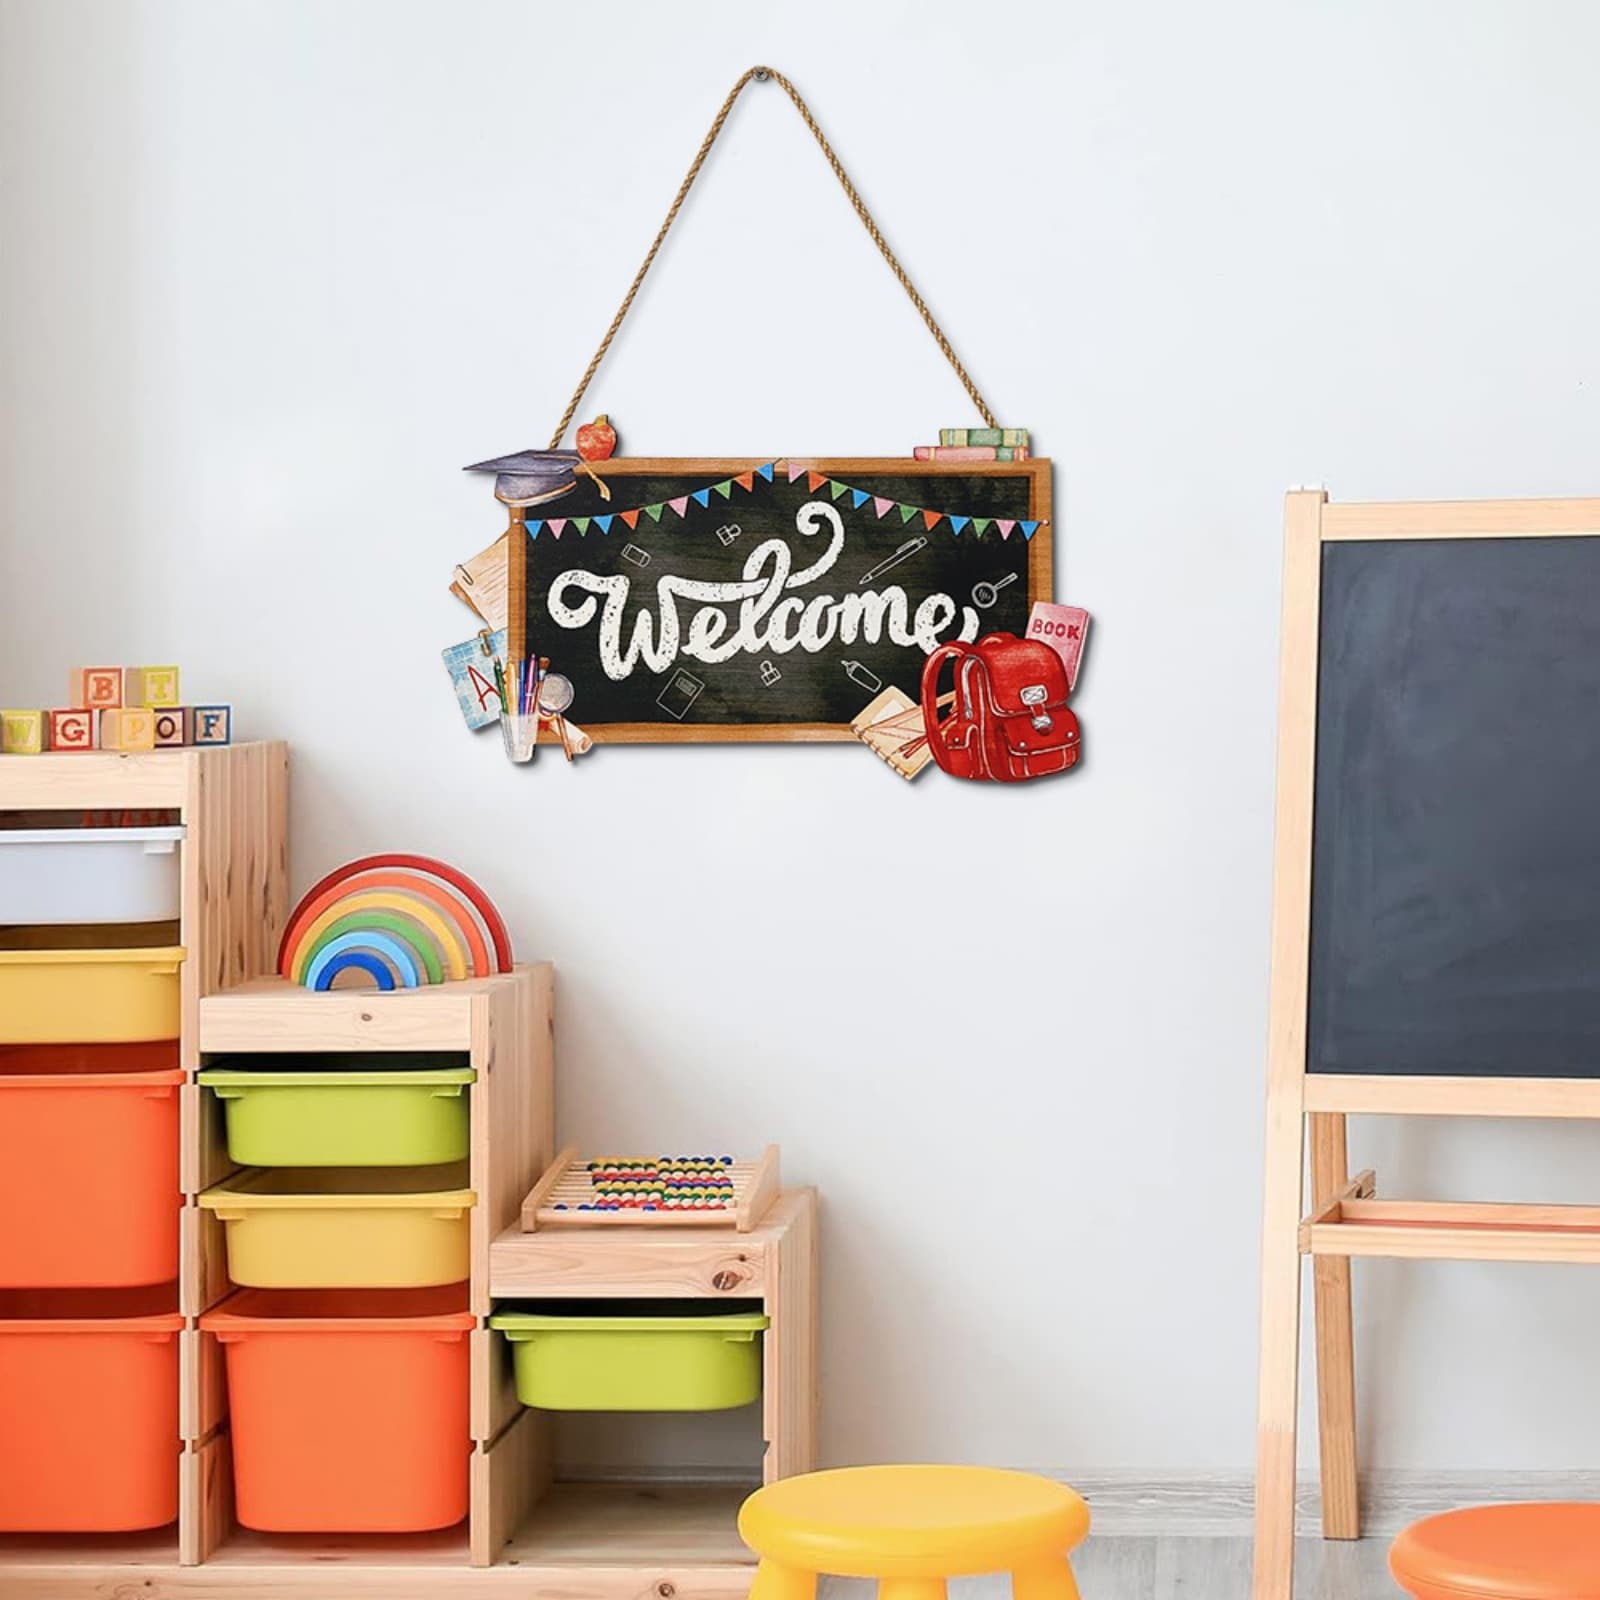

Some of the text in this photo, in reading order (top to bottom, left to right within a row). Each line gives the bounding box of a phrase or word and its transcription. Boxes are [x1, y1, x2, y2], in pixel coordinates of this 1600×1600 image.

[547, 501, 979, 680] Welcome
[1032, 618, 1080, 640] BOOK
[92, 676, 114, 701] B
[151, 674, 176, 699] T
[7, 719, 34, 742] W
[61, 718, 86, 742] G
[127, 718, 145, 743] P
[156, 716, 176, 739] O
[202, 714, 220, 738] F
